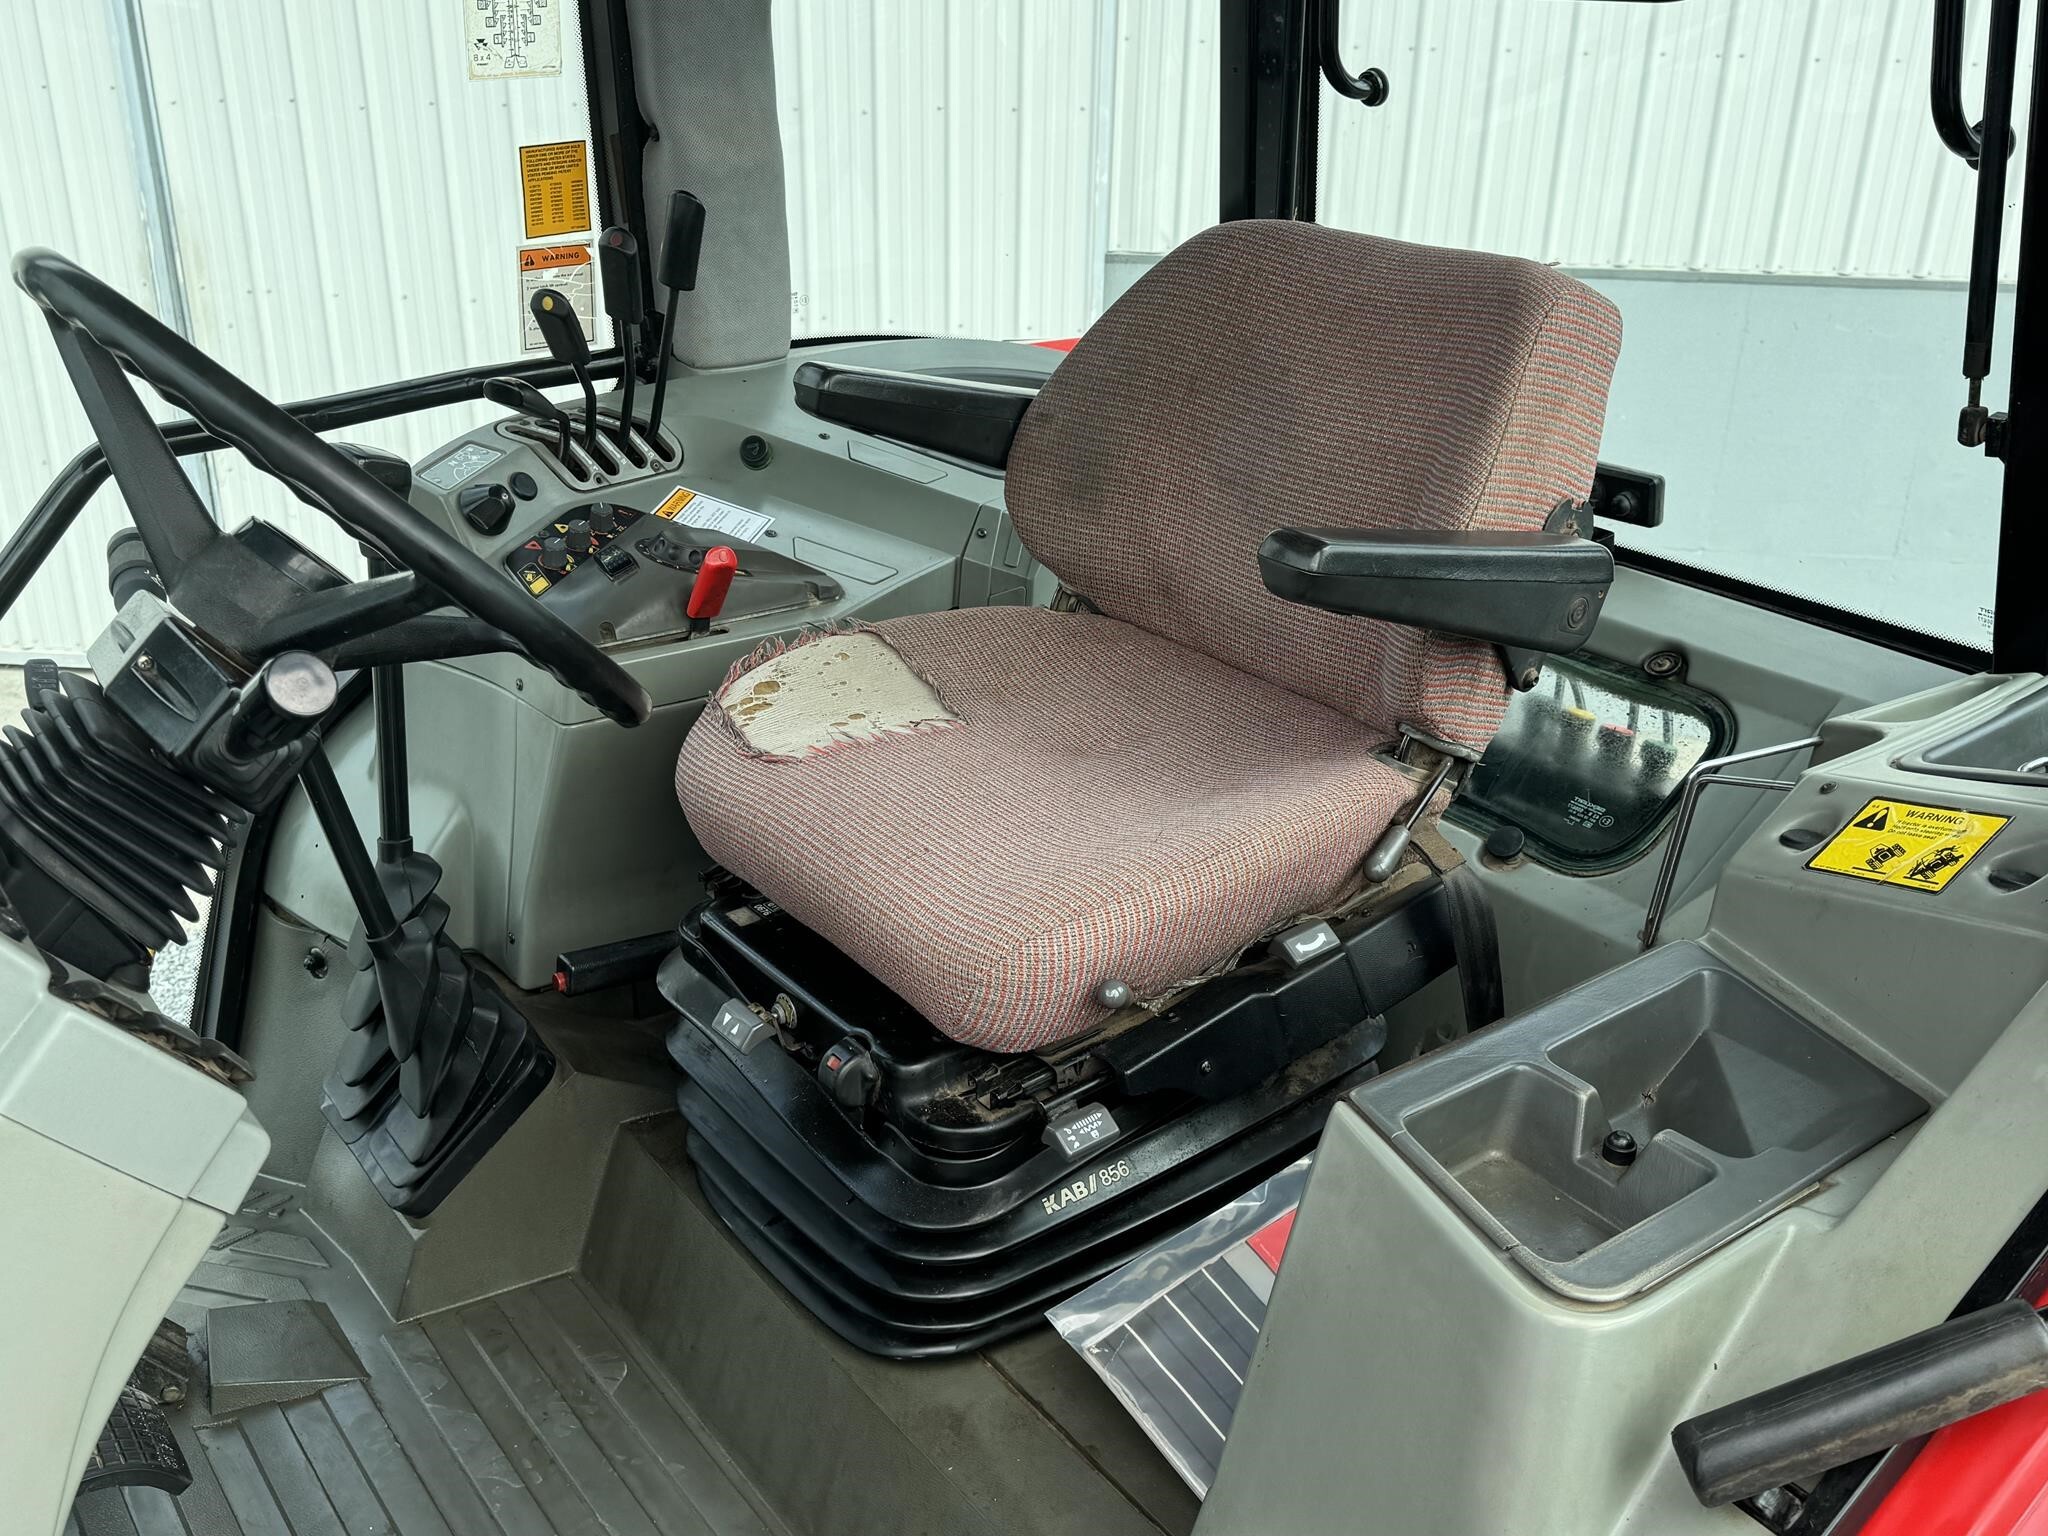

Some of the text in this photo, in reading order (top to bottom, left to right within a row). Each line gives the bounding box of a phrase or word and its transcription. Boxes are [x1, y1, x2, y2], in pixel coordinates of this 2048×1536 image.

[542, 252, 580, 262] WARNING
[669, 491, 691, 512] WARNING
[1905, 809, 1965, 825] WARNING
[1099, 1160, 1130, 1186] 856
